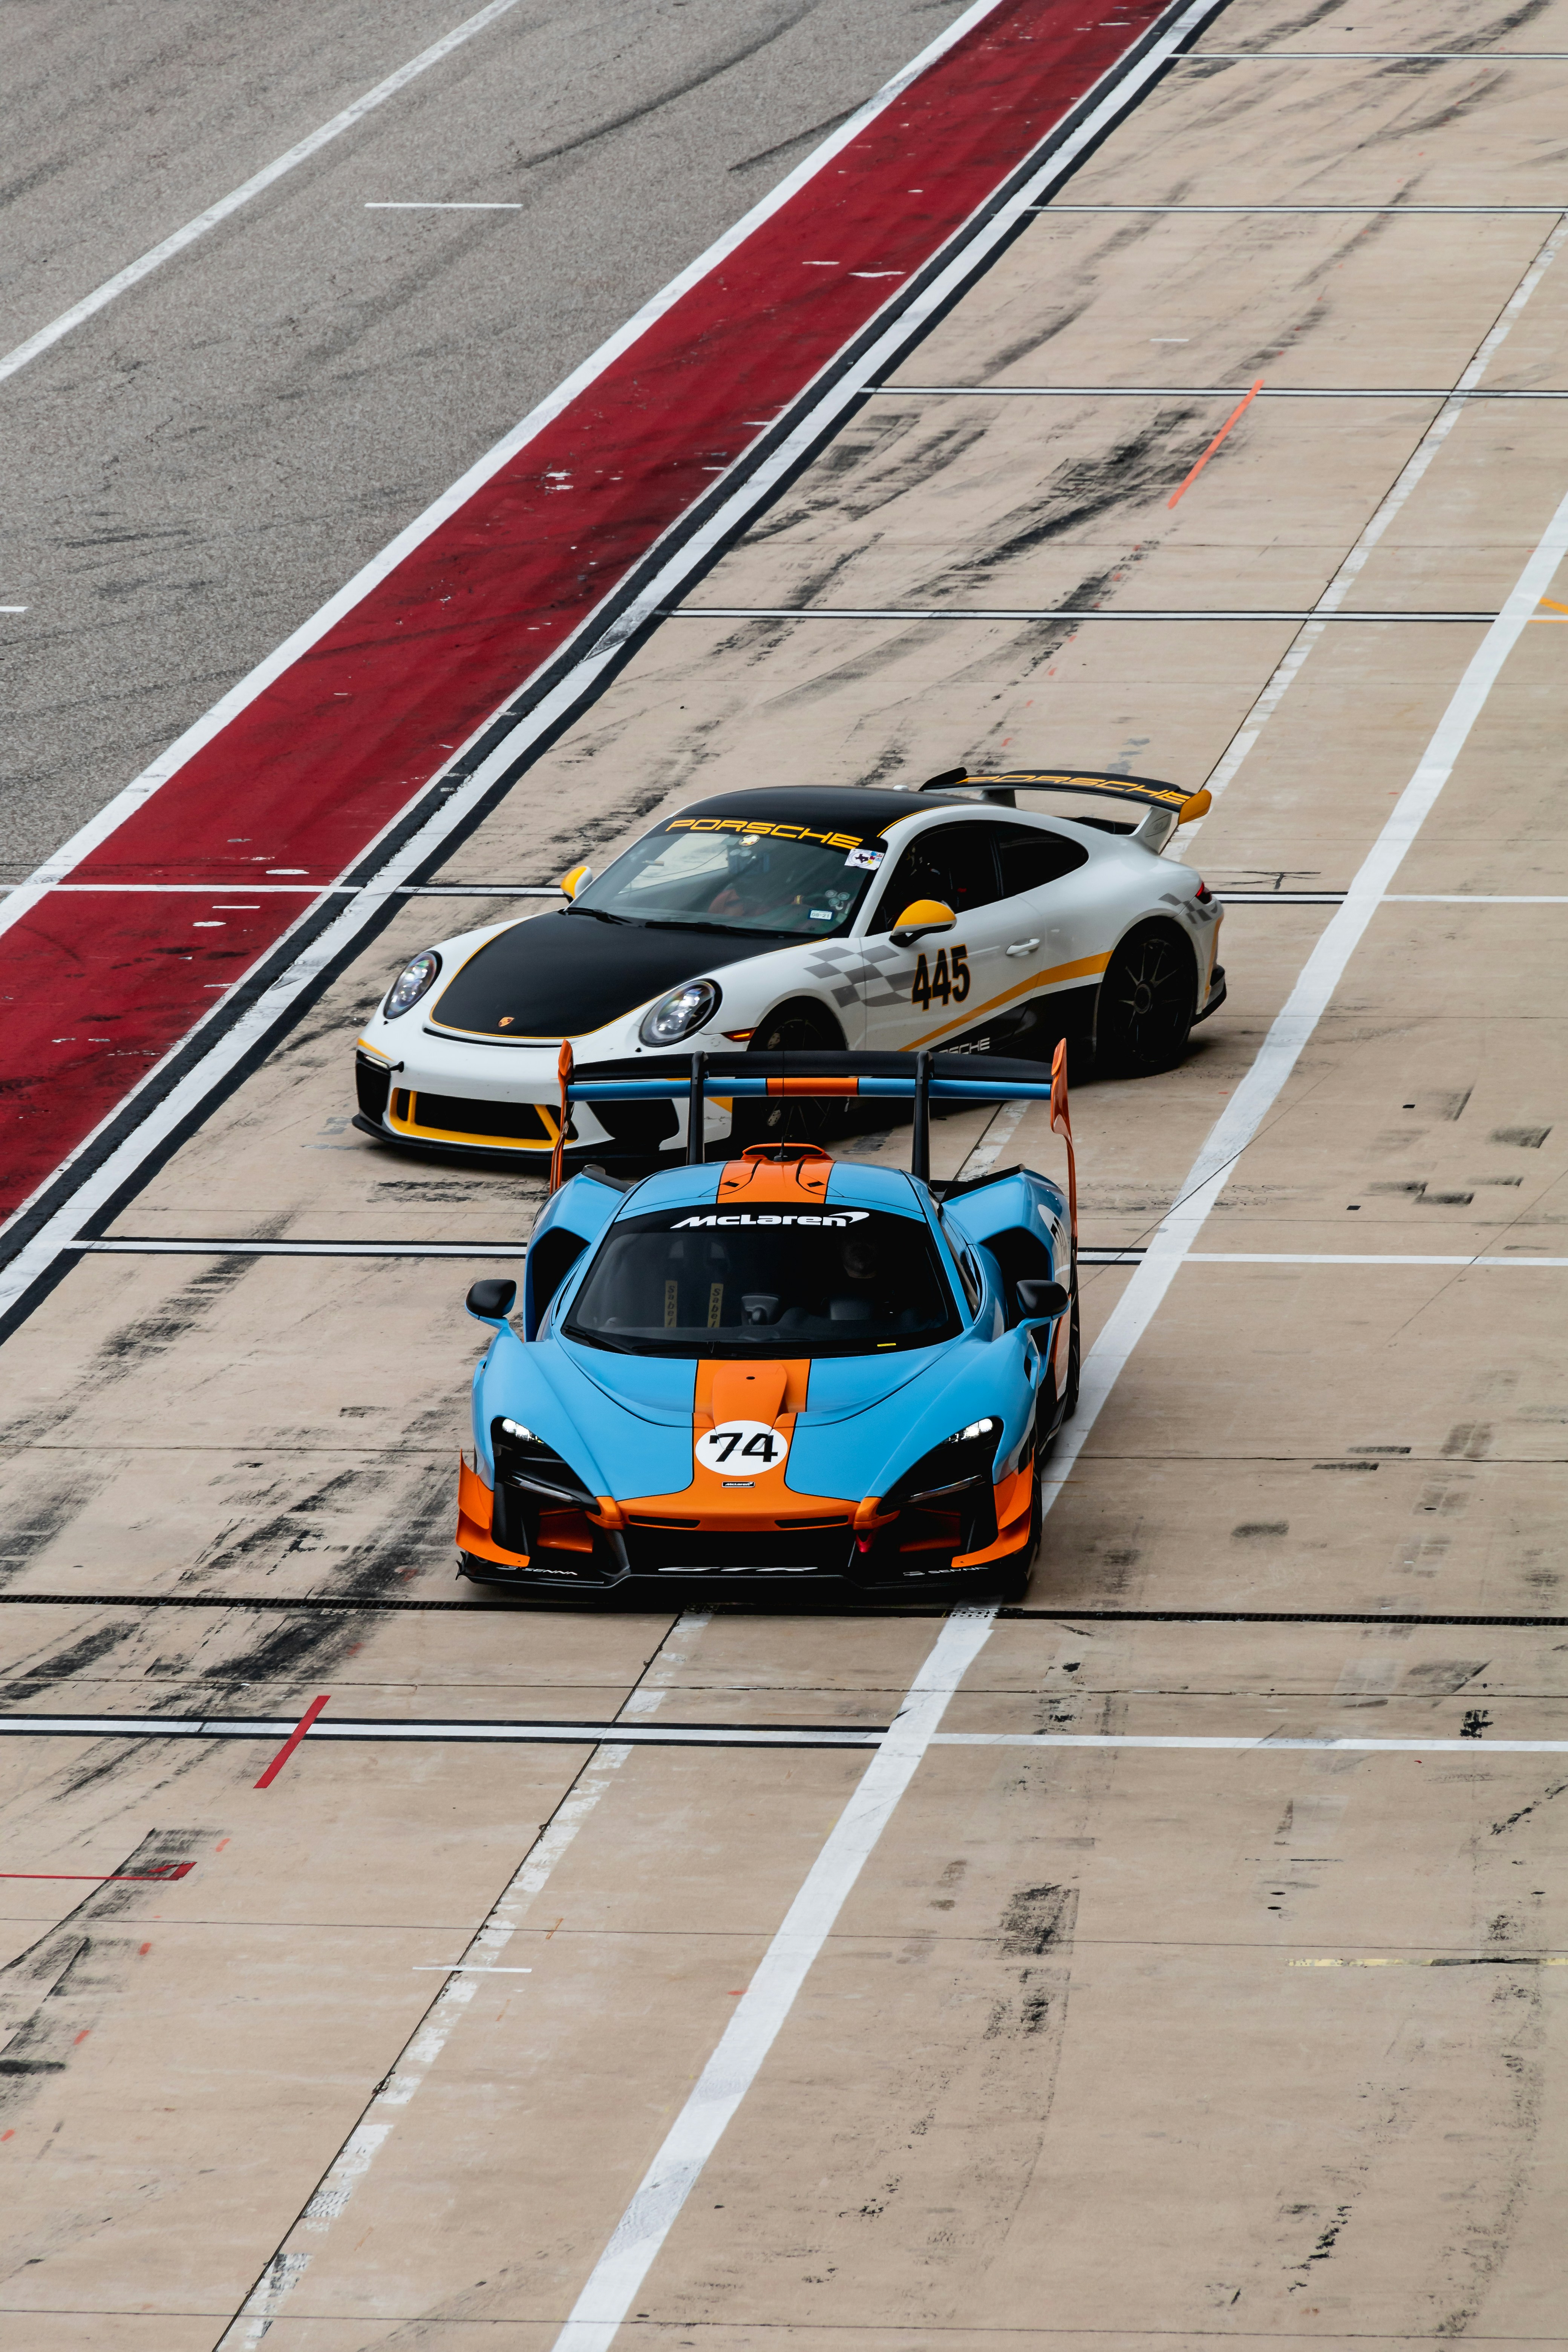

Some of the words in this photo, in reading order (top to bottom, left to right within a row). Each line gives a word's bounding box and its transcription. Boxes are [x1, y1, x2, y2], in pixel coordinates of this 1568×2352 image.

[956, 775, 1192, 805] PORSCHE
[665, 819, 864, 849] PORSCHE
[912, 944, 971, 1012] 445
[670, 1213, 870, 1229] McLaren
[709, 1433, 778, 1462] 74
